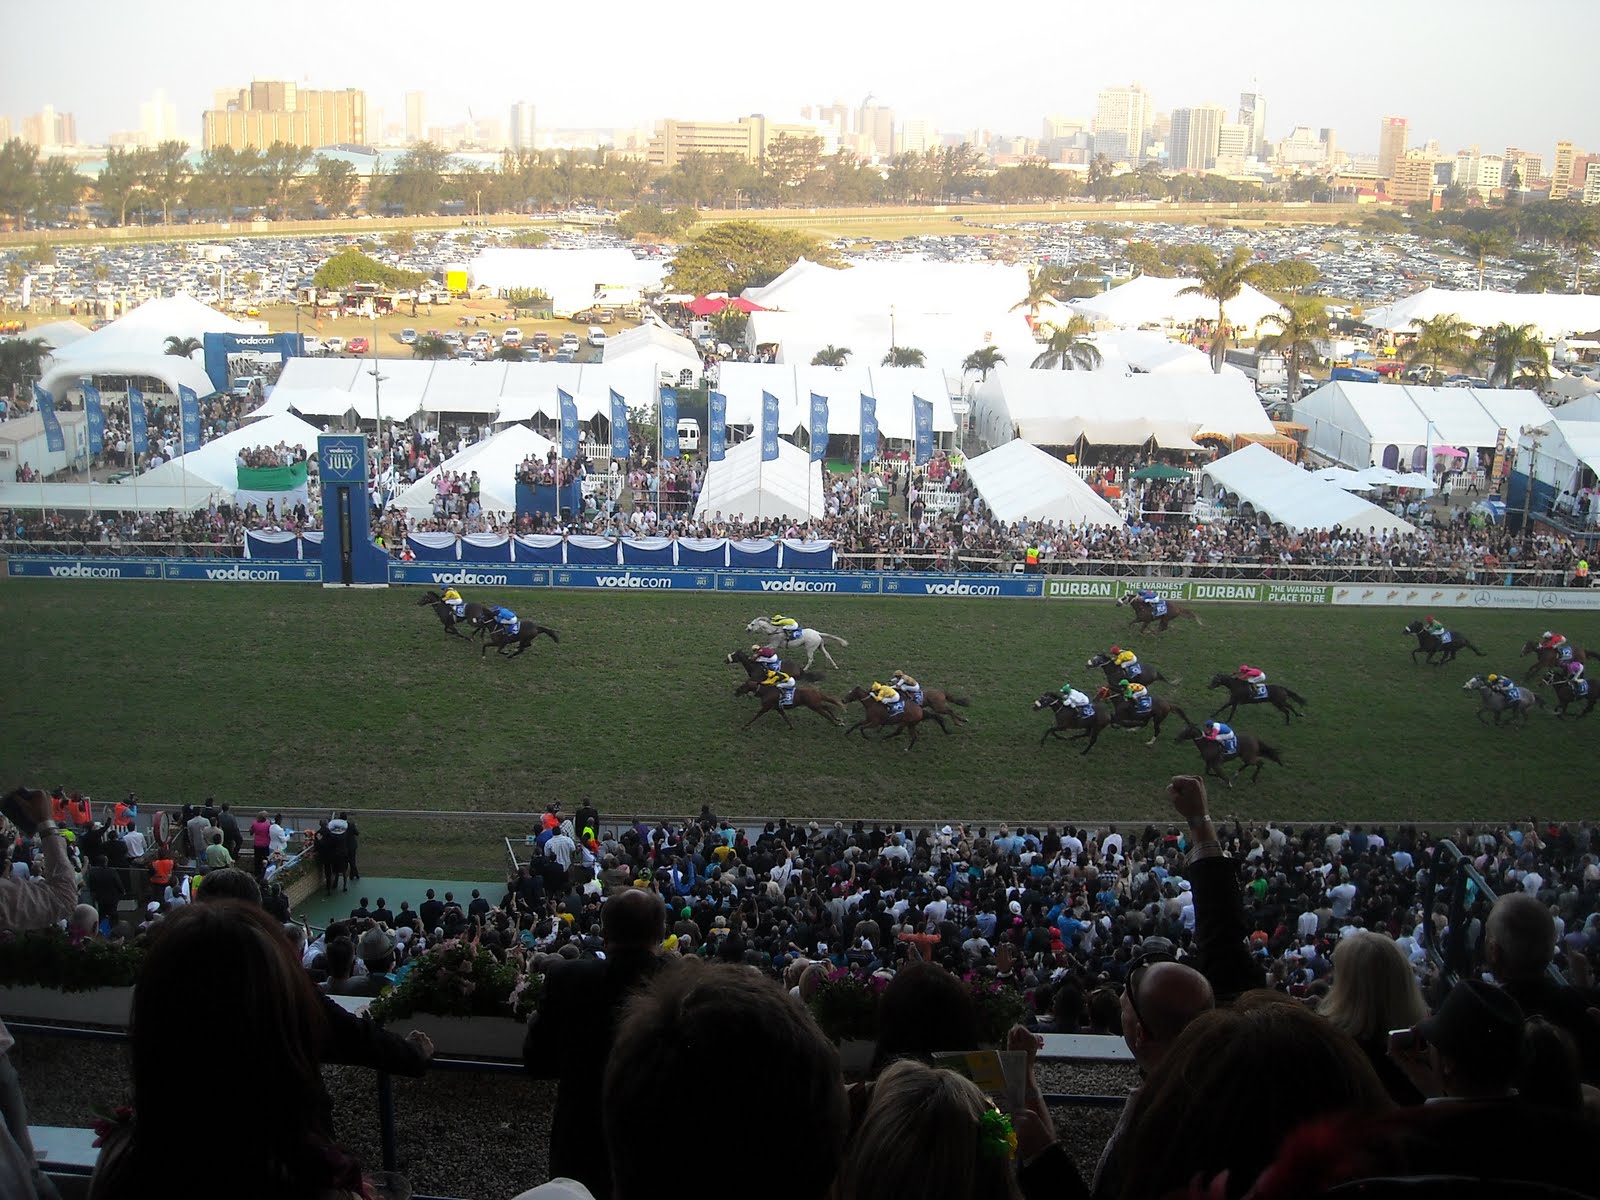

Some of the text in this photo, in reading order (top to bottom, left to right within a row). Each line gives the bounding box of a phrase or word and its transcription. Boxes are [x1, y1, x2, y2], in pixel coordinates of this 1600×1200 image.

[236, 336, 274, 345] vodacom
[328, 456, 353, 470] JULY
[50, 562, 120, 578] vodacom
[206, 565, 280, 581] vodacom
[432, 568, 507, 585] vodacom
[596, 572, 671, 588] vodacom
[761, 576, 836, 592] vodacom
[1125, 582, 1183, 590] THE WARMEST
[925, 580, 1000, 596] vodacom
[1050, 582, 1111, 596] DURBAN
[1157, 590, 1183, 599] TO BE
[1196, 585, 1256, 599] DURBAN
[1270, 585, 1327, 594] THE WARMEST
[1268, 593, 1326, 603] PLACE TO BE
